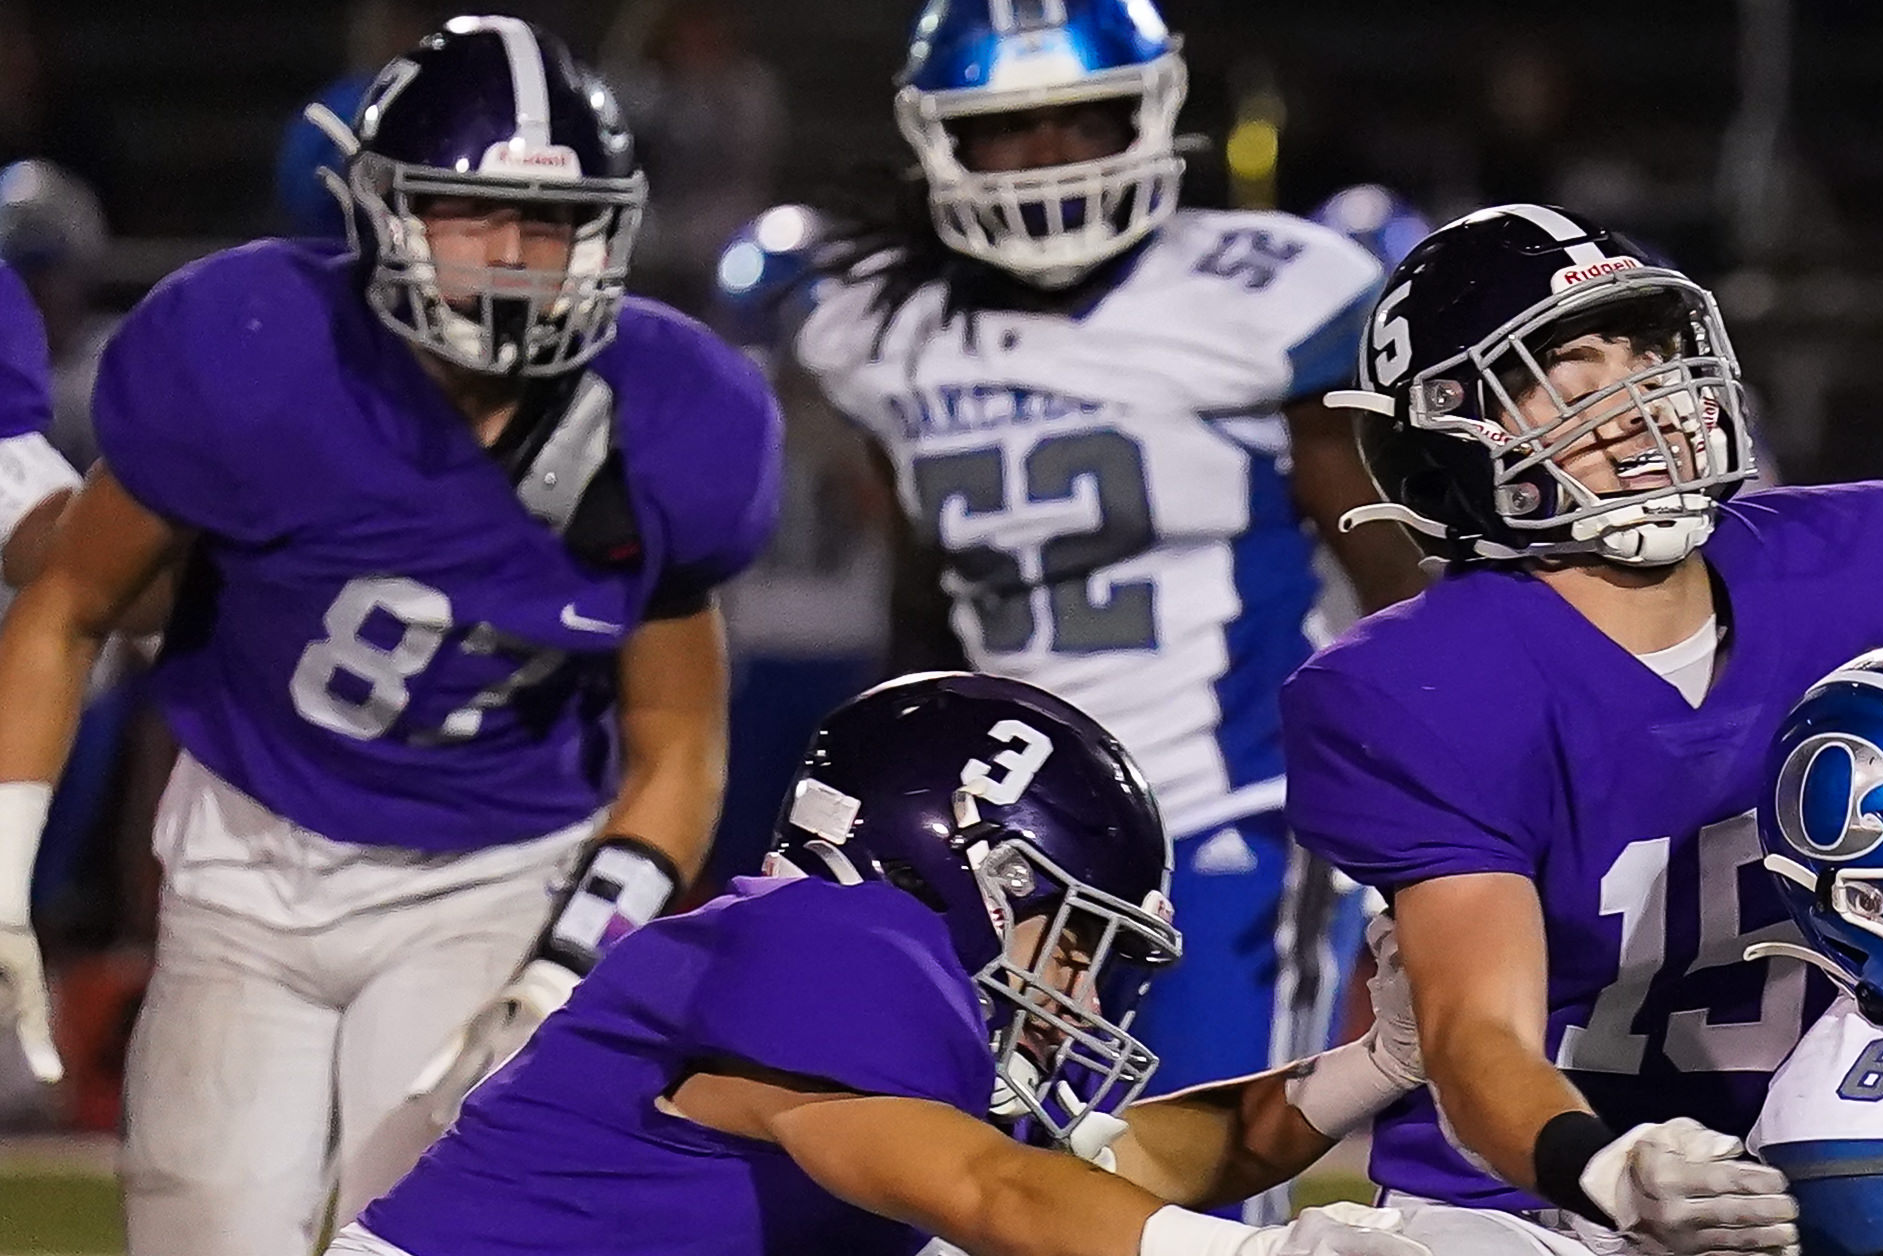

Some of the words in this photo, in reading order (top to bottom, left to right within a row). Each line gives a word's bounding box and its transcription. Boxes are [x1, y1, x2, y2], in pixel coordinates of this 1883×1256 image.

[1564, 258, 1638, 285] Riddell
[912, 428, 1160, 661] 52
[289, 575, 567, 746] 87
[961, 720, 1054, 804] 3
[1556, 806, 1806, 1075] 15
